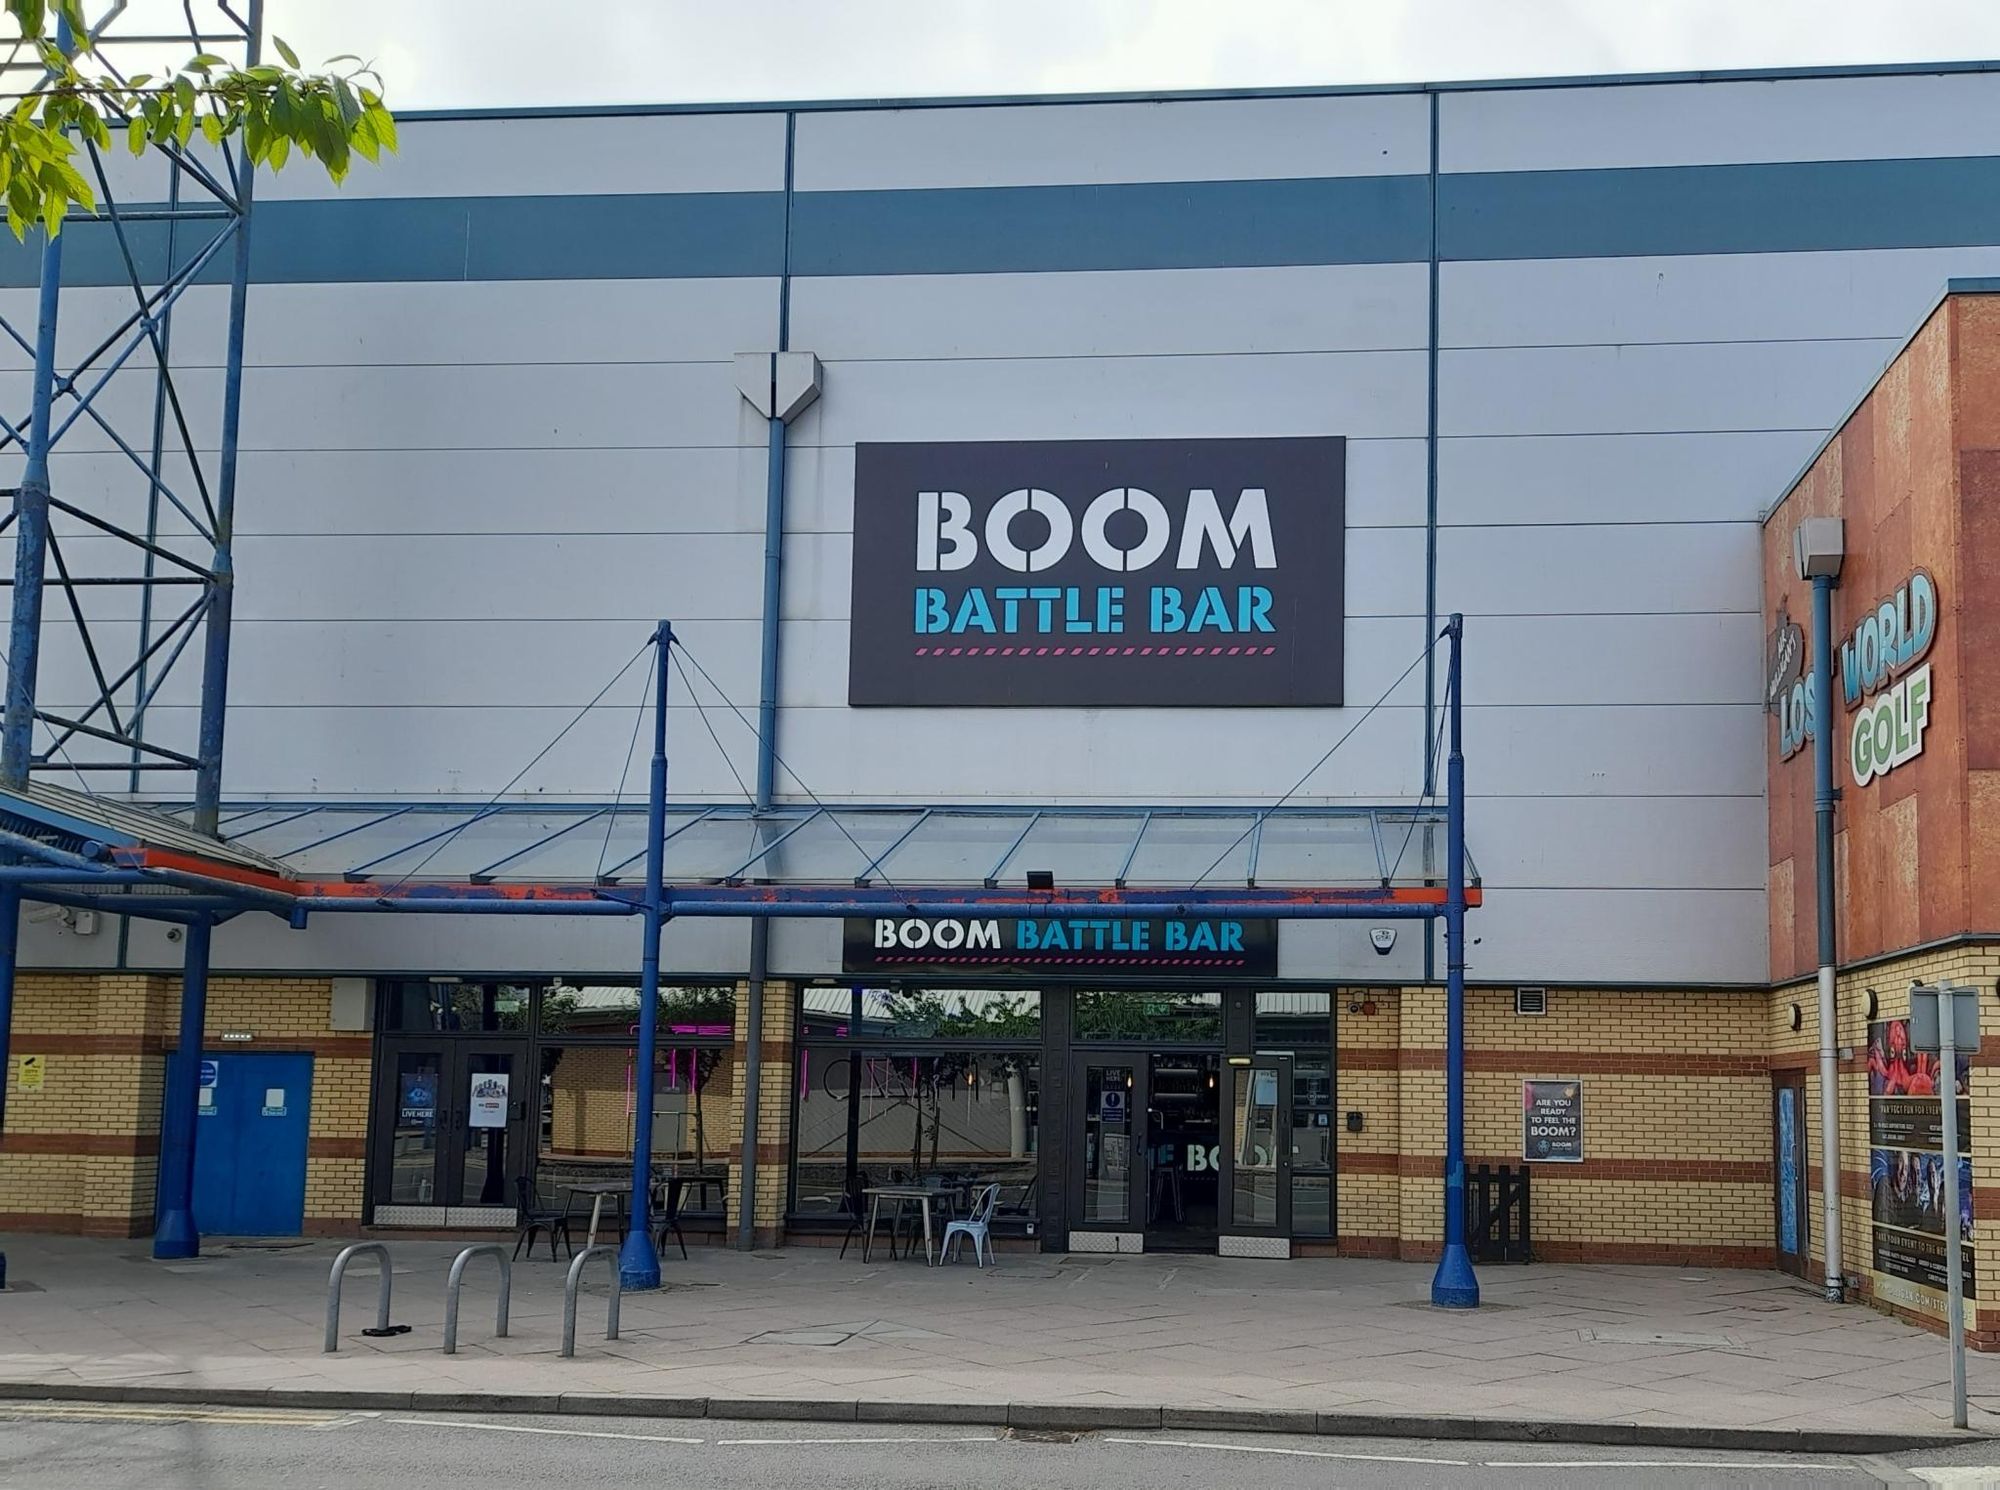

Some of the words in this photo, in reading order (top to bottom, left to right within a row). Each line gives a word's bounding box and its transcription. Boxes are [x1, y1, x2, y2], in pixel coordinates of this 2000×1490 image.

[915, 487, 1278, 573] BOOM
[914, 586, 1125, 634] BATTLE
[1150, 585, 1277, 633] BAR
[1839, 571, 1936, 706] WORLD
[1779, 669, 1816, 757] LOS
[1853, 669, 1930, 782] GOLF
[874, 918, 1002, 950] BOOM
[1017, 920, 1150, 951] BATTLE
[1165, 921, 1245, 952] BAR
[1530, 1116, 1542, 1124] TO
[1544, 1116, 1560, 1124] FEEL
[1562, 1117, 1576, 1125] THE
[1530, 1126, 1577, 1136] BOOM?
